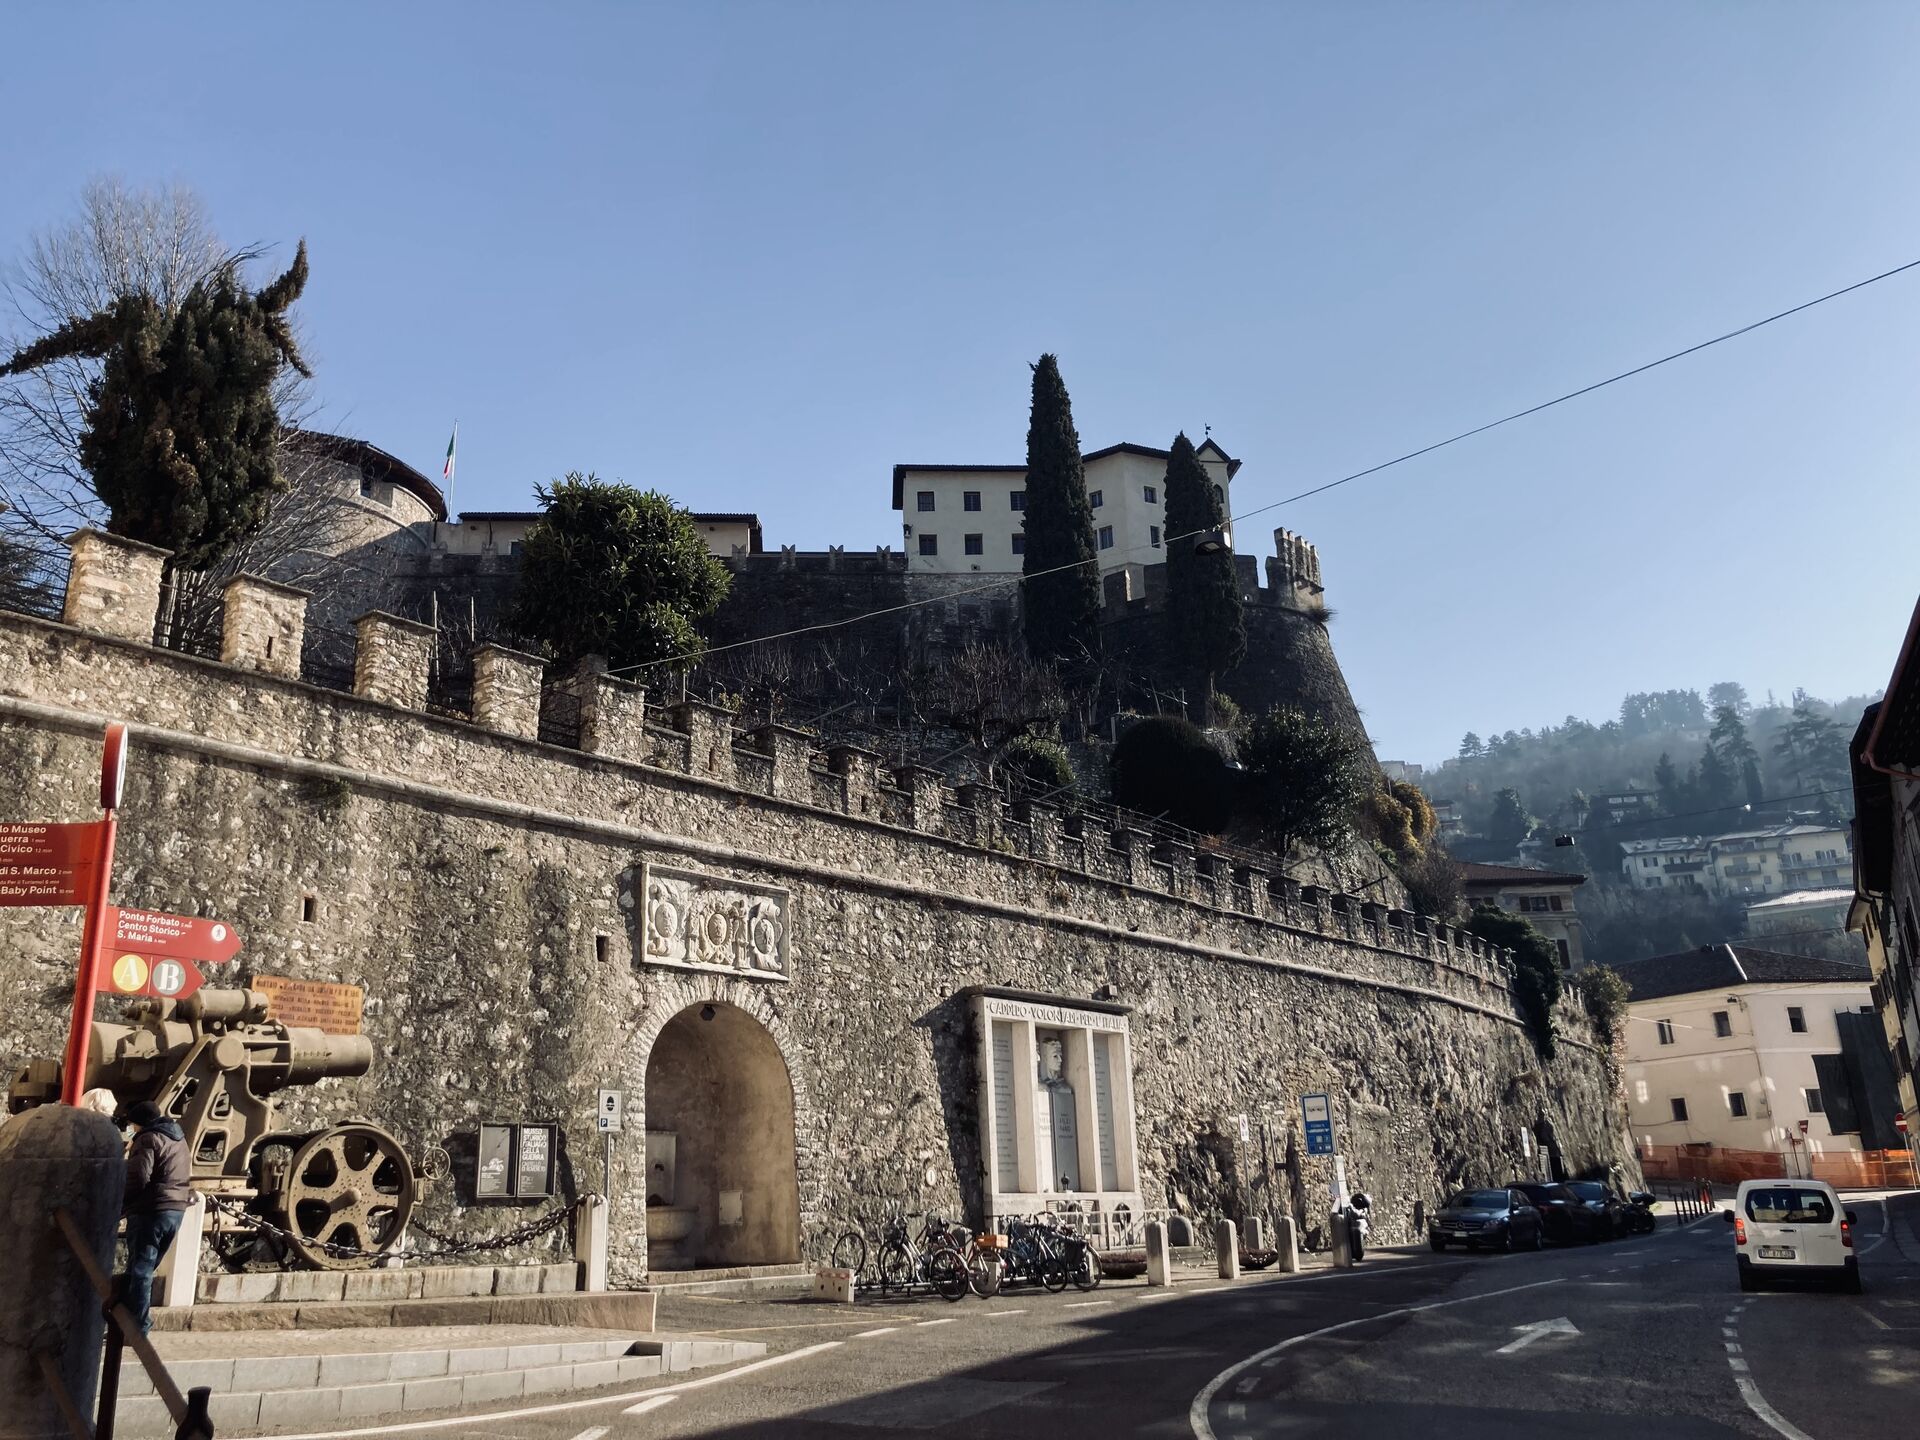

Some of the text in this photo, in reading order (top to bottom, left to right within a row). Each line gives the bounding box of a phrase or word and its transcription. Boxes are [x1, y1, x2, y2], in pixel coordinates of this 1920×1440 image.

[11, 825, 47, 833] Museo
[0, 844, 33, 853] Civico
[10, 866, 21, 875] S.
[23, 866, 57, 875] Marco
[1, 885, 28, 897] Baby
[29, 885, 57, 894] Point
[119, 910, 145, 922] Ponte
[146, 914, 180, 927] Forbato
[118, 920, 148, 932] Centro
[149, 924, 180, 936] Storico
[117, 930, 126, 939] S.
[128, 931, 153, 943] Maria
[118, 958, 180, 991] A B
